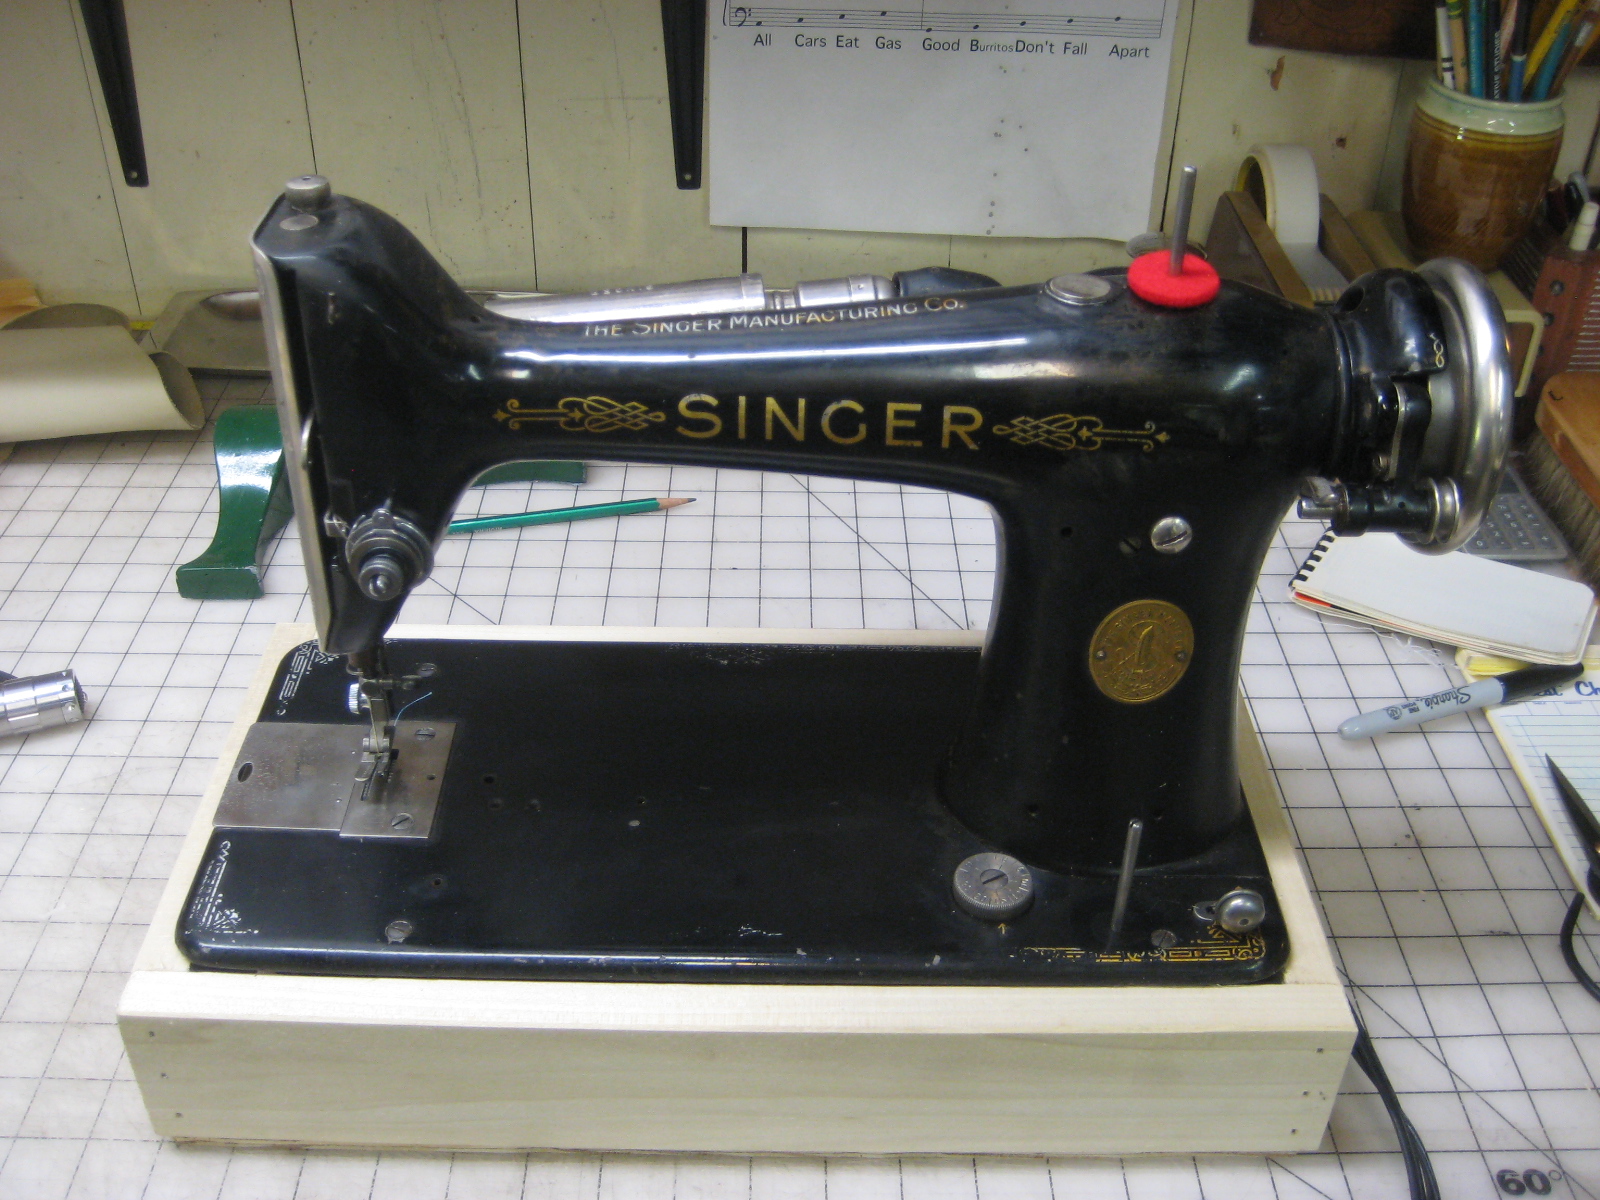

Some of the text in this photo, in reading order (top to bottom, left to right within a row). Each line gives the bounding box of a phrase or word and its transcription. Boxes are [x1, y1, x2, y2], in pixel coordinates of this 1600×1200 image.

[753, 33, 1150, 60] All Cars Eat Gas Good Burritos Don't Fall Apart
[584, 322, 623, 337] THE
[631, 318, 722, 336] SINGER
[729, 301, 918, 330] MANUFACTURING
[675, 393, 984, 451] SINGER
[1424, 685, 1472, 710] Sharpie
